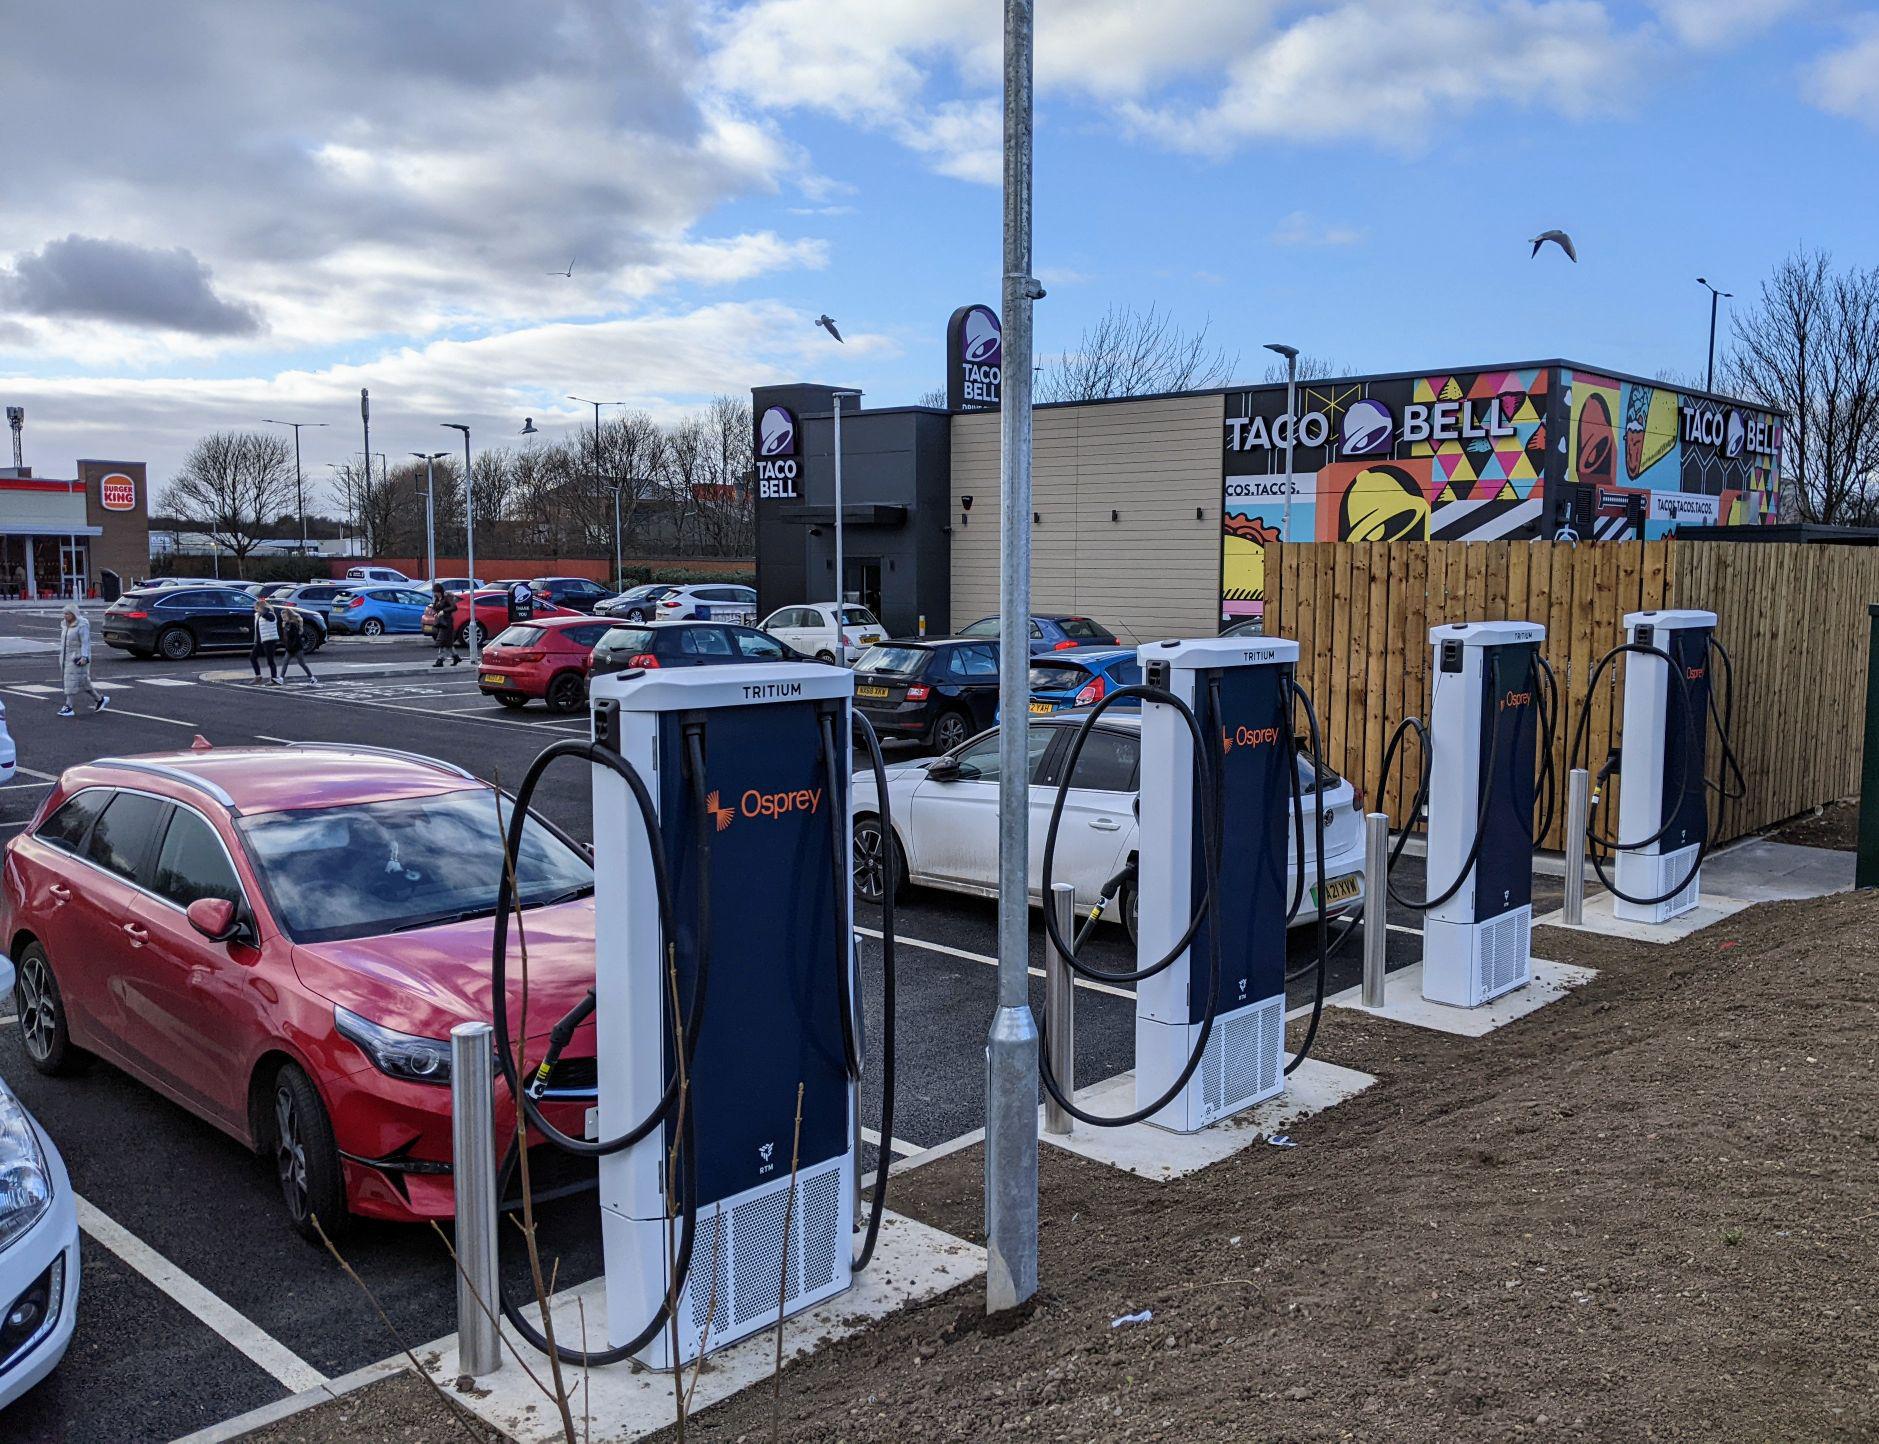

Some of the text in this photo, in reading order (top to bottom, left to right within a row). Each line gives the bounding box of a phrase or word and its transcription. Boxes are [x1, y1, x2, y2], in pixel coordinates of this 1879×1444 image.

[962, 363, 1001, 385] TACO
[963, 381, 999, 402] BELL
[1225, 399, 1515, 451] TACO BELL
[1683, 407, 1779, 455] TACO BELL
[756, 459, 797, 479] TACO
[103, 485, 133, 493] BURGER
[104, 492, 134, 503] KING
[760, 479, 797, 498] BELL
[1243, 650, 1275, 661] TRITIUM
[742, 682, 802, 699] TRITIUM
[1506, 690, 1532, 708] Osprey
[1236, 726, 1279, 748] Osprey
[741, 788, 822, 820] Osprey
[759, 1163, 774, 1175] RTM
